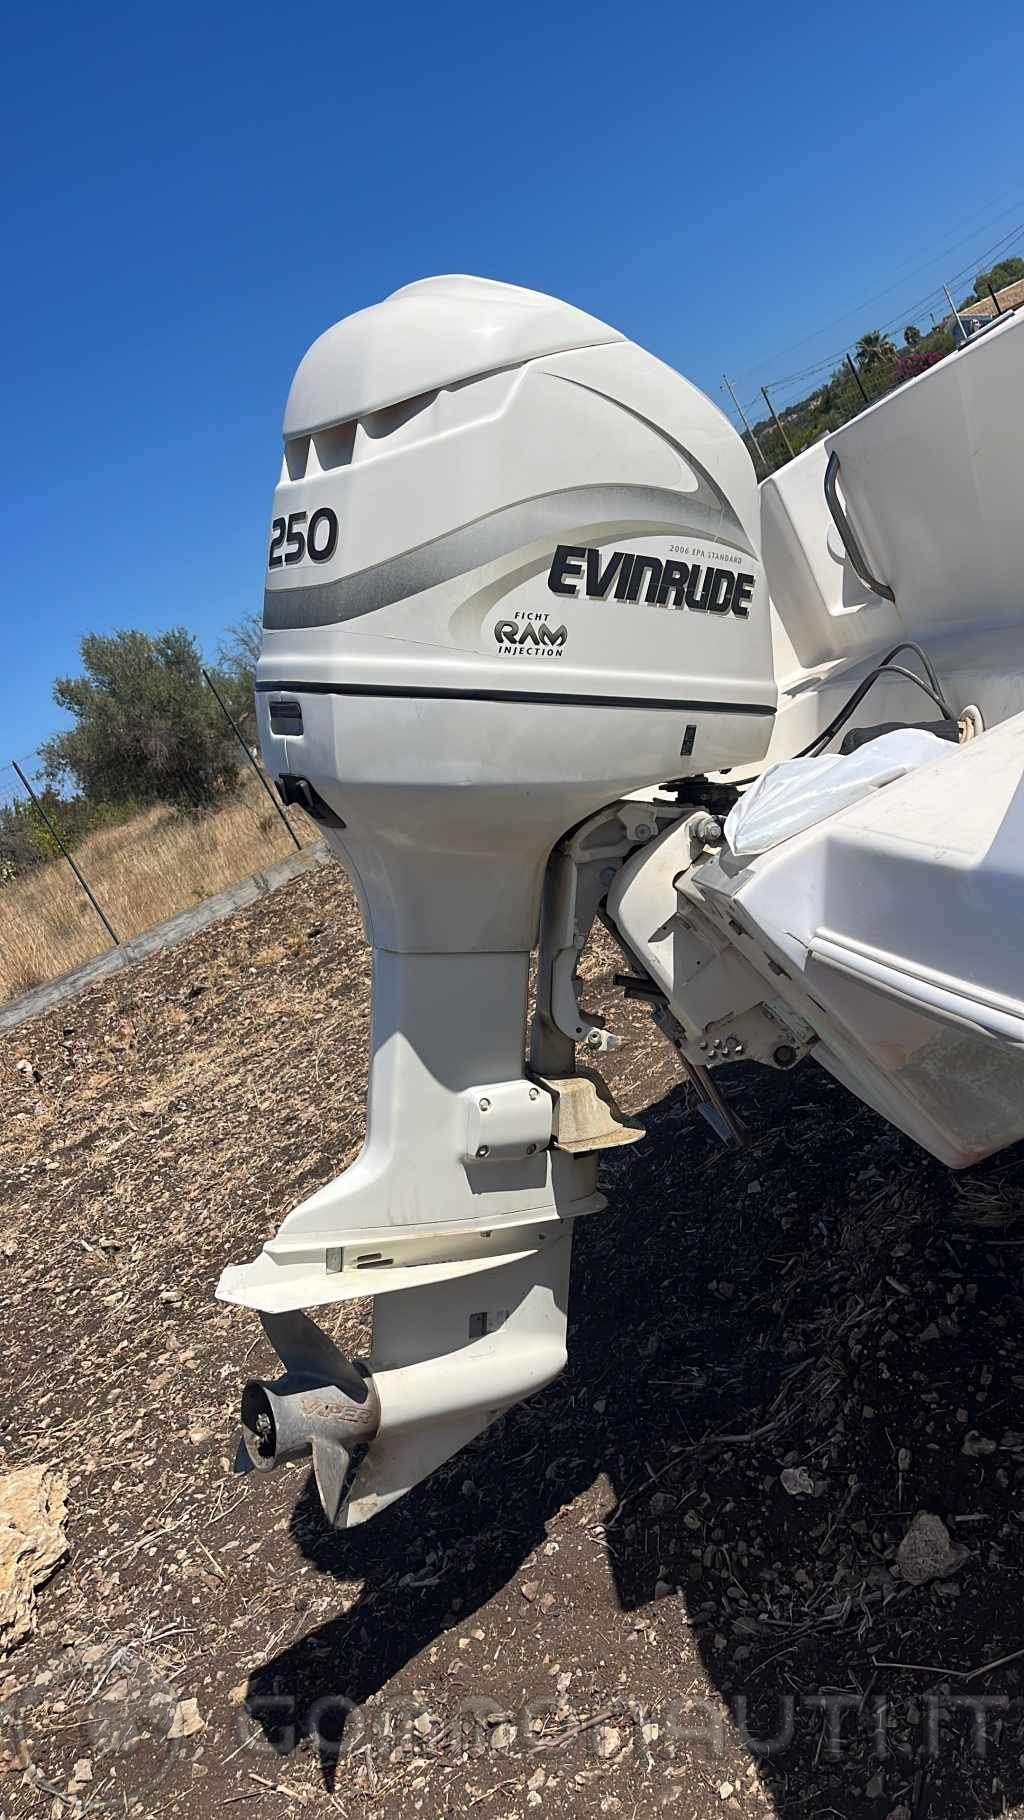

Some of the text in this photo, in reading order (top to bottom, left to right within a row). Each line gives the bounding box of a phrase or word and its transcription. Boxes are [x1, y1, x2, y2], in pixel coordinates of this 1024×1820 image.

[268, 507, 339, 570] 250
[668, 544, 742, 564] 2006 EPA STANDARD
[547, 544, 755, 619] EVINRUDE
[514, 611, 550, 621] FICHT
[494, 620, 568, 646] RAM
[498, 646, 563, 657] INJECTION
